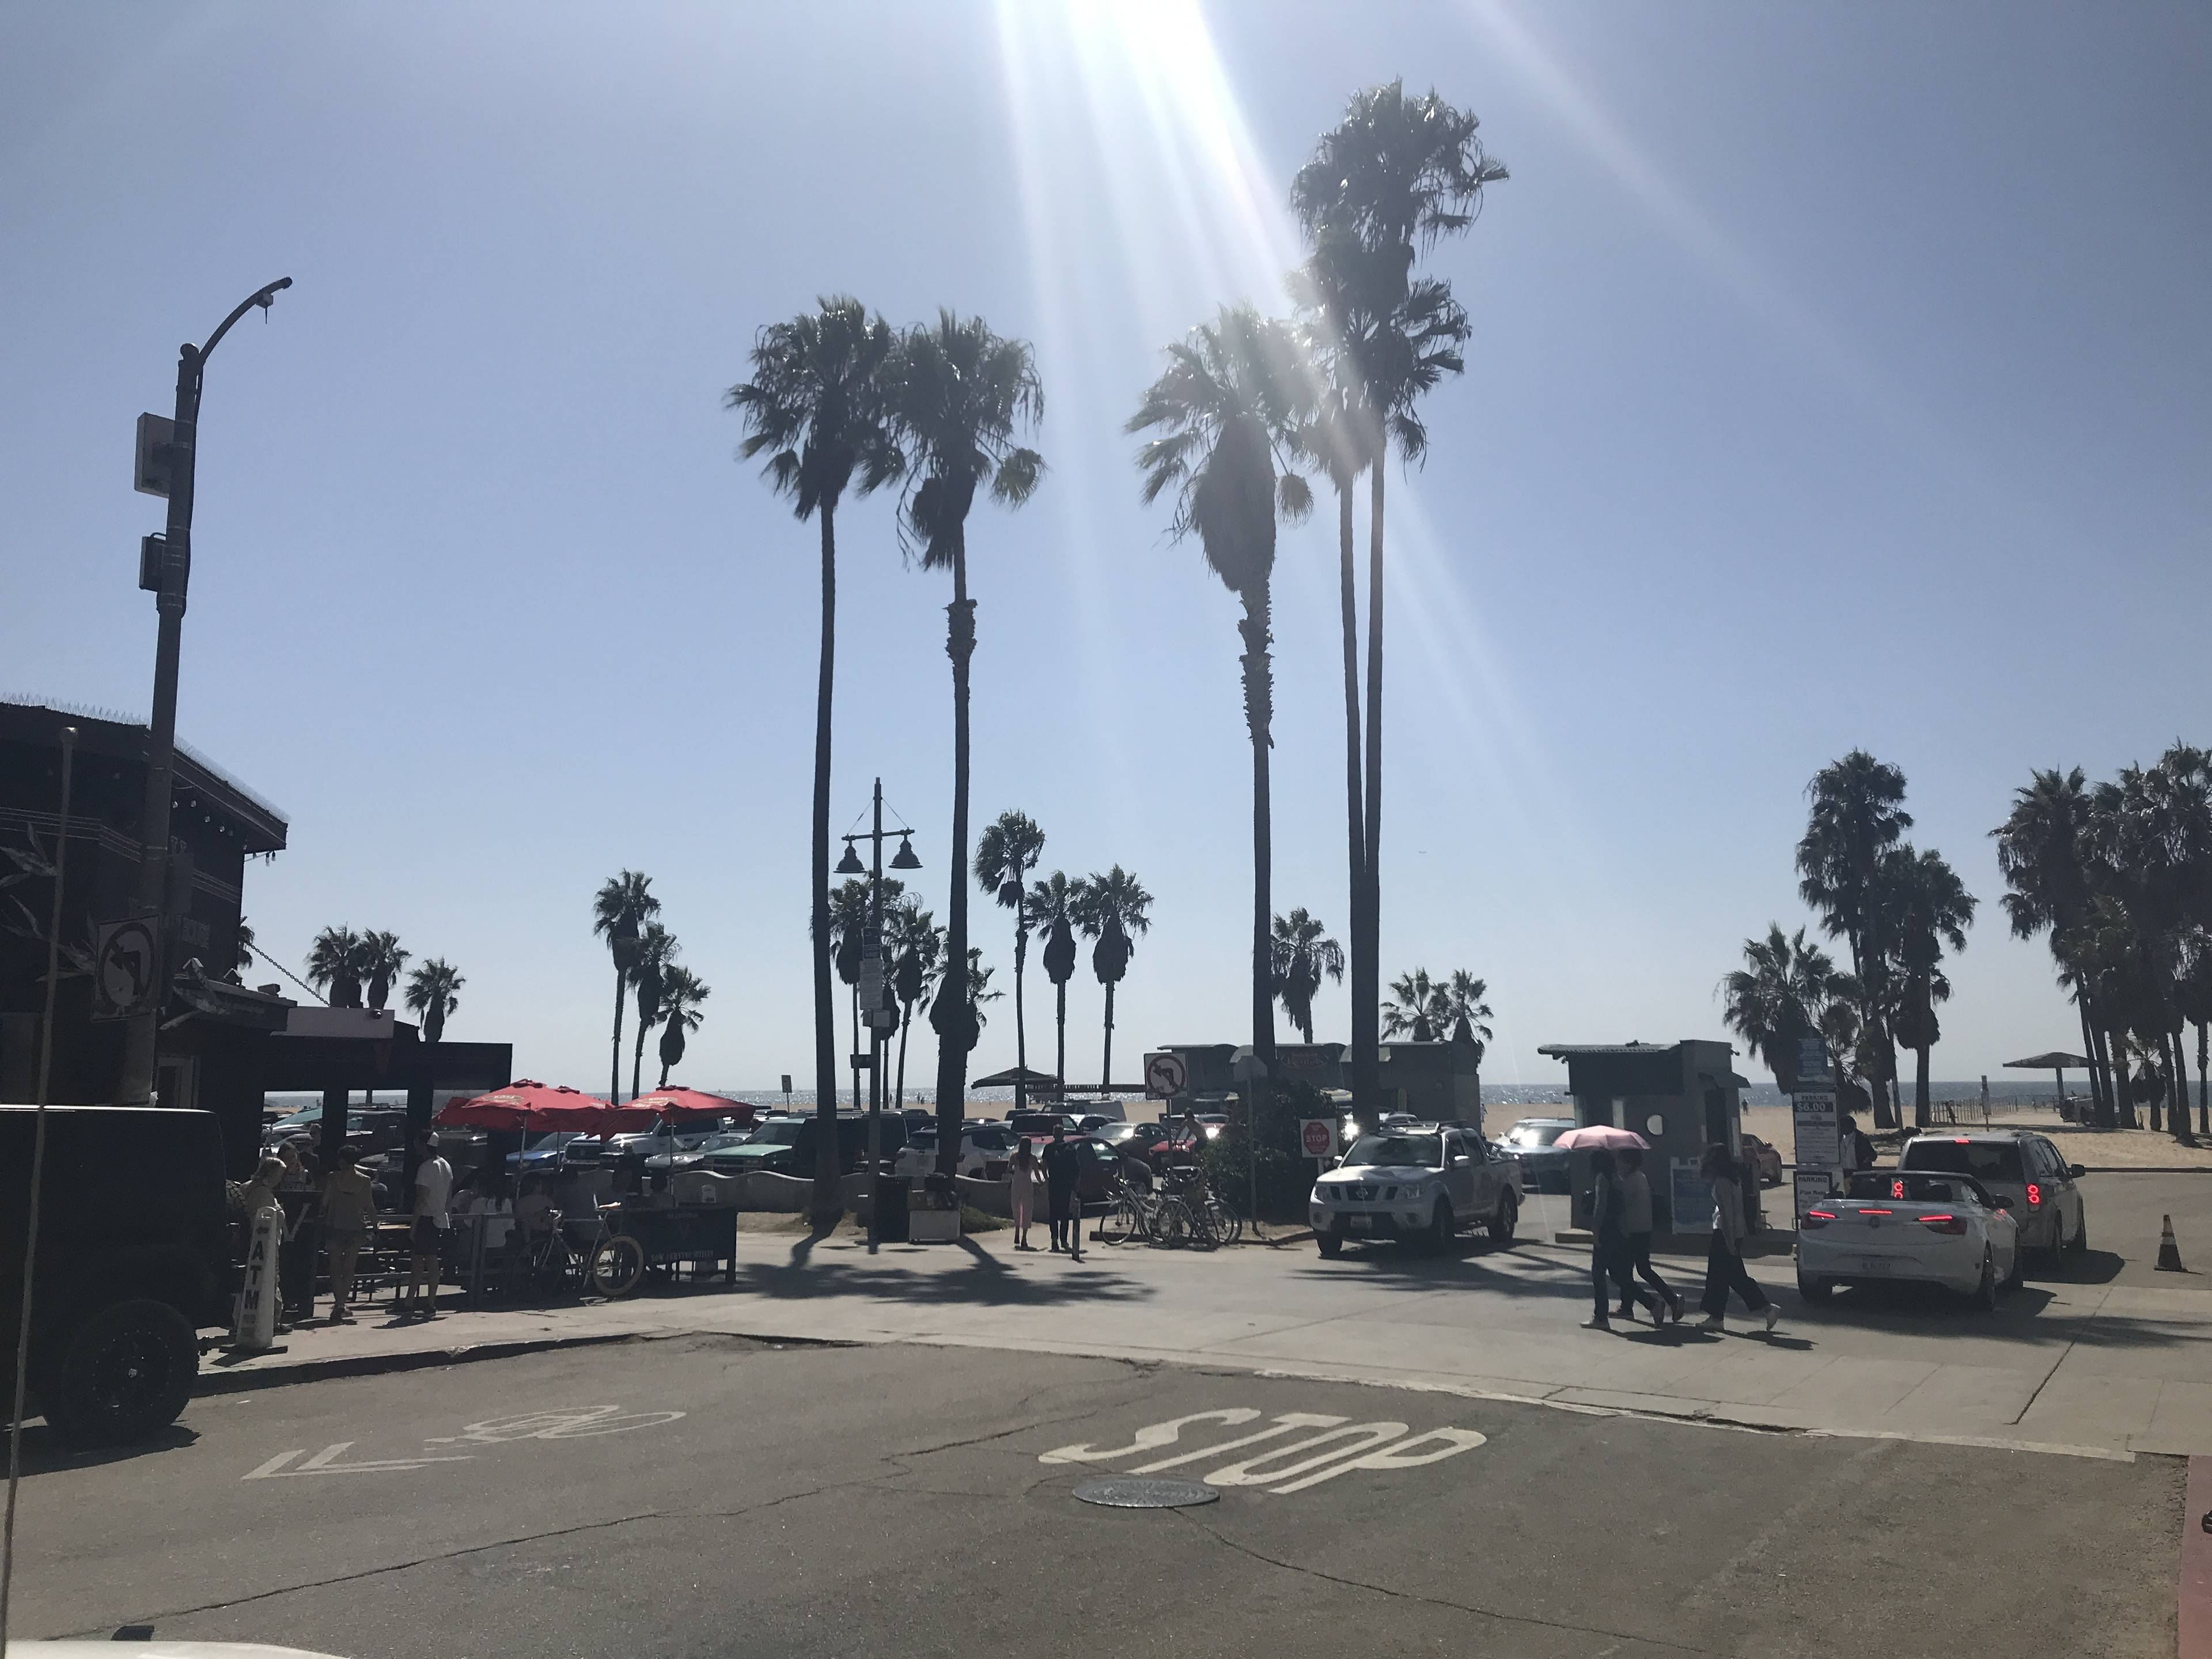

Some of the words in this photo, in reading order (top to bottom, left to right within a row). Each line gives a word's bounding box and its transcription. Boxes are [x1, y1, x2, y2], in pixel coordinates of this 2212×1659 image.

[1797, 1102, 1825, 1112] $6.00
[1306, 1134, 1327, 1143] STOP
[244, 1240, 263, 1309] ATM
[1037, 1407, 1488, 1494] STOP
